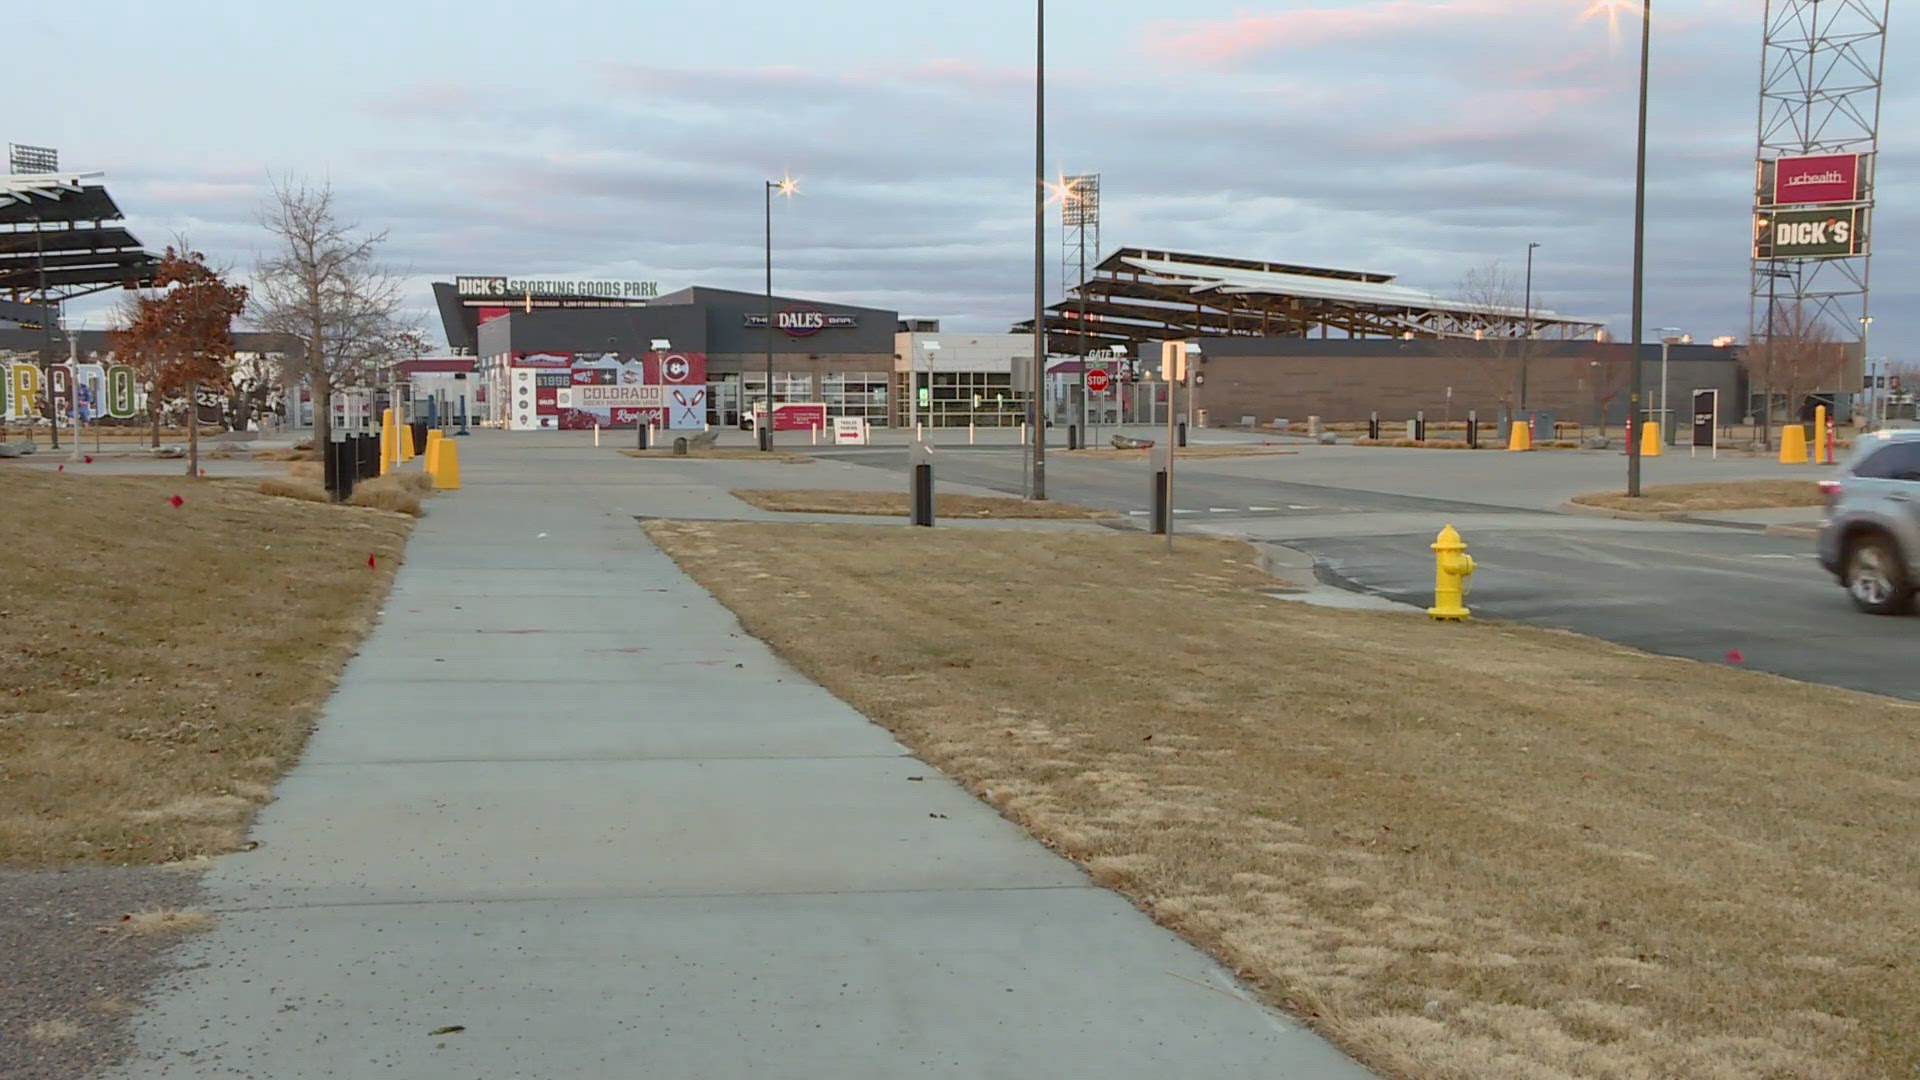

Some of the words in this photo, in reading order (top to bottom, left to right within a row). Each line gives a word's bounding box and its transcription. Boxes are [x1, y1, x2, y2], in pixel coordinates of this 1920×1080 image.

[1788, 170, 1842, 186] uchealth
[1776, 218, 1849, 245] DICK'S
[458, 277, 505, 295] DICK'S
[511, 280, 575, 297] SPORTING
[578, 281, 621, 296] GOODS
[624, 281, 658, 296] PARK
[779, 312, 823, 328] DALE'S
[1089, 349, 1112, 360] GATE
[1088, 376, 1107, 385] STOP
[0, 363, 136, 418] RADO
[583, 388, 659, 400] COLORADO
[197, 392, 218, 407] 23
